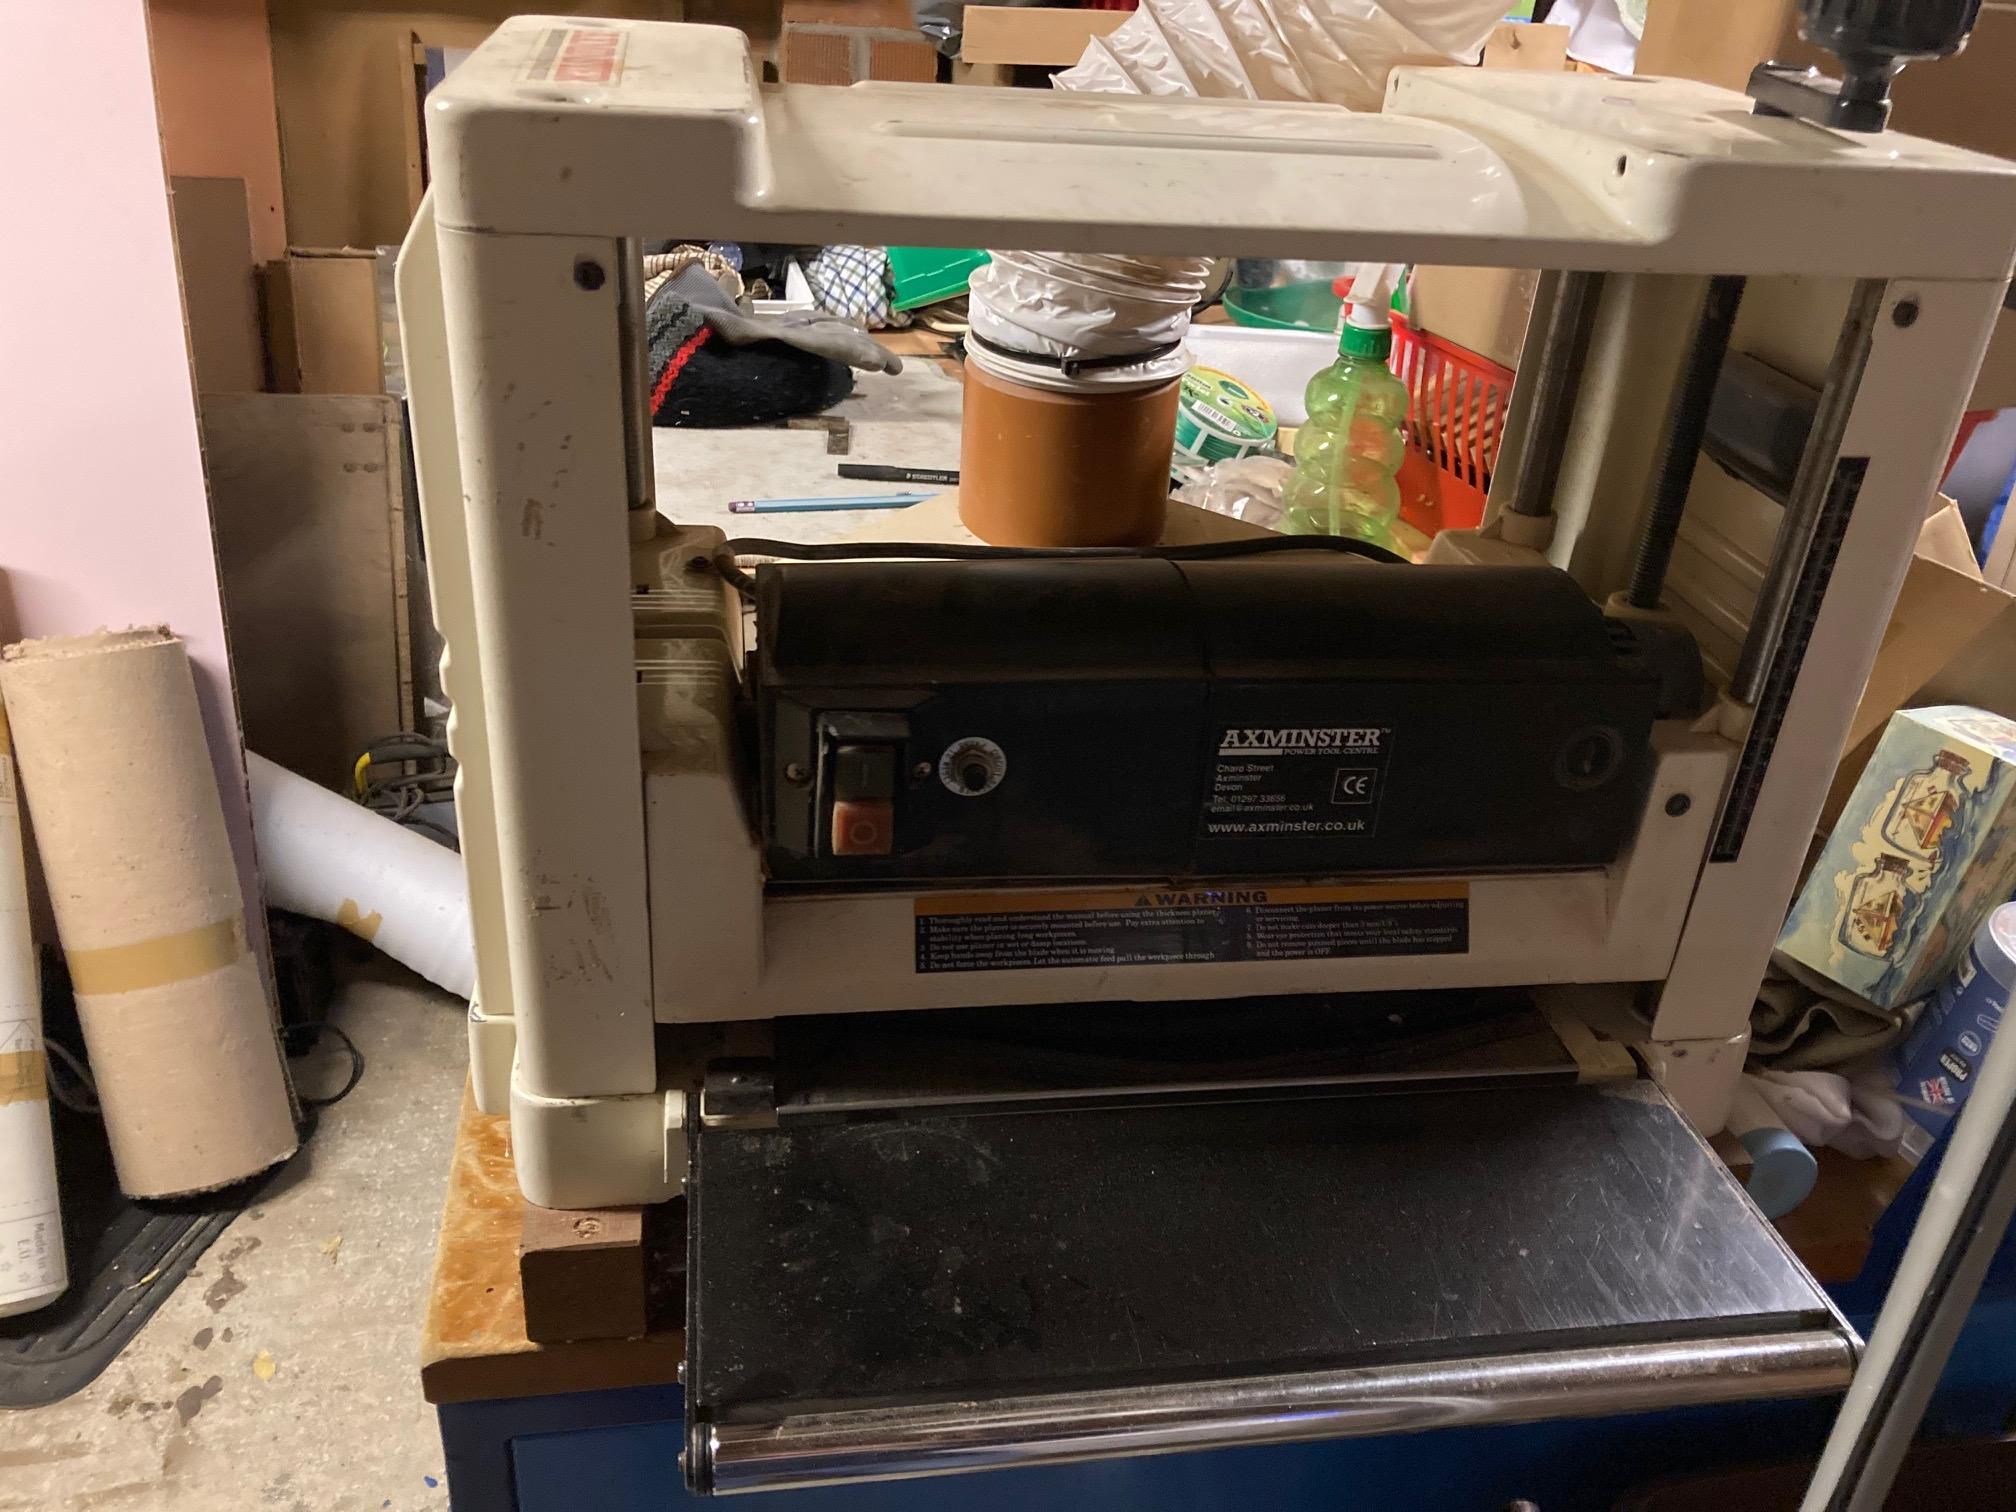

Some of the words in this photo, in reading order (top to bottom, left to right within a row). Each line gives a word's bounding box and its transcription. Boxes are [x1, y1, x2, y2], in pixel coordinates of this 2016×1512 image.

[1219, 728, 1381, 748] AXMINSTER
[1283, 747, 1317, 756] POWER
[1318, 747, 1342, 756] TOOL
[1343, 746, 1379, 755] CENTRE
[1246, 763, 1275, 773] Street
[1216, 774, 1263, 782] Axminster
[1214, 783, 1243, 792] Devon
[1207, 818, 1366, 834] www.axminster.co.uk
[1154, 891, 1268, 906] WARNING
